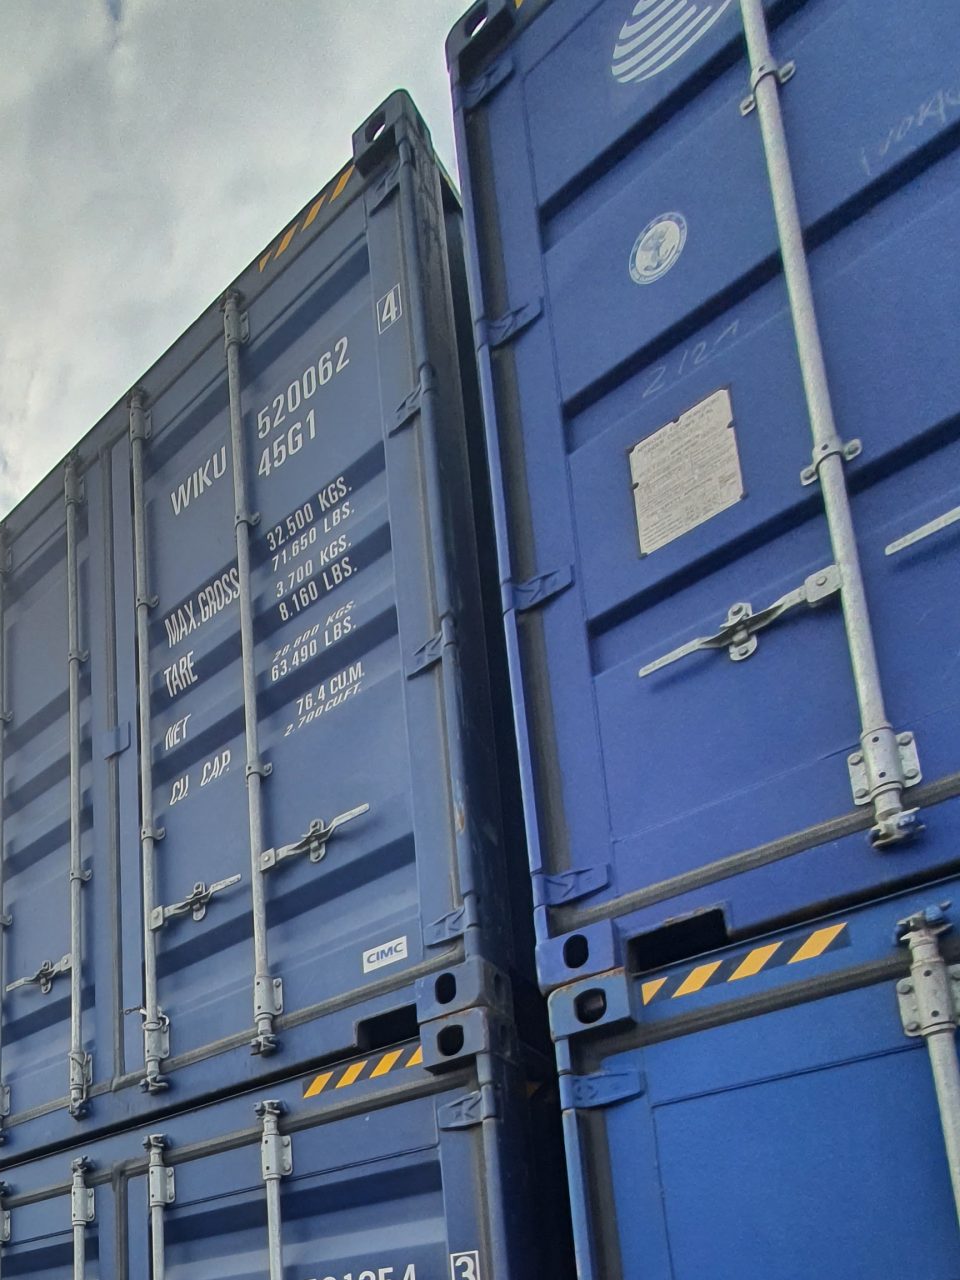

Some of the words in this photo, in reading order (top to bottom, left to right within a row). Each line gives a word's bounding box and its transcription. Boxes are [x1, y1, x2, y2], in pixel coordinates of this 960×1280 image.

[380, 291, 399, 323] 4
[170, 445, 228, 516] WIKU
[257, 336, 350, 440] 520062
[258, 409, 317, 477] 45G1
[164, 567, 241, 648] MAX.GROSS
[266, 503, 315, 551] 32.500
[317, 476, 353, 512] KGS.
[271, 525, 317, 573] 71.650
[323, 501, 355, 533] LBS.
[163, 651, 198, 698] TARE
[275, 560, 314, 598] 3.700
[319, 534, 352, 564] KGS.
[279, 583, 318, 621] 8.160
[323, 556, 358, 591] LBS.
[271, 639, 318, 682] 63.490
[324, 616, 357, 647] LBS.
[165, 714, 192, 750] NET
[169, 775, 189, 806] CU.
[200, 750, 231, 787] CAP.
[296, 684, 326, 715] 76.4
[329, 662, 365, 693] CU.M.
[366, 942, 404, 964] CIMC
